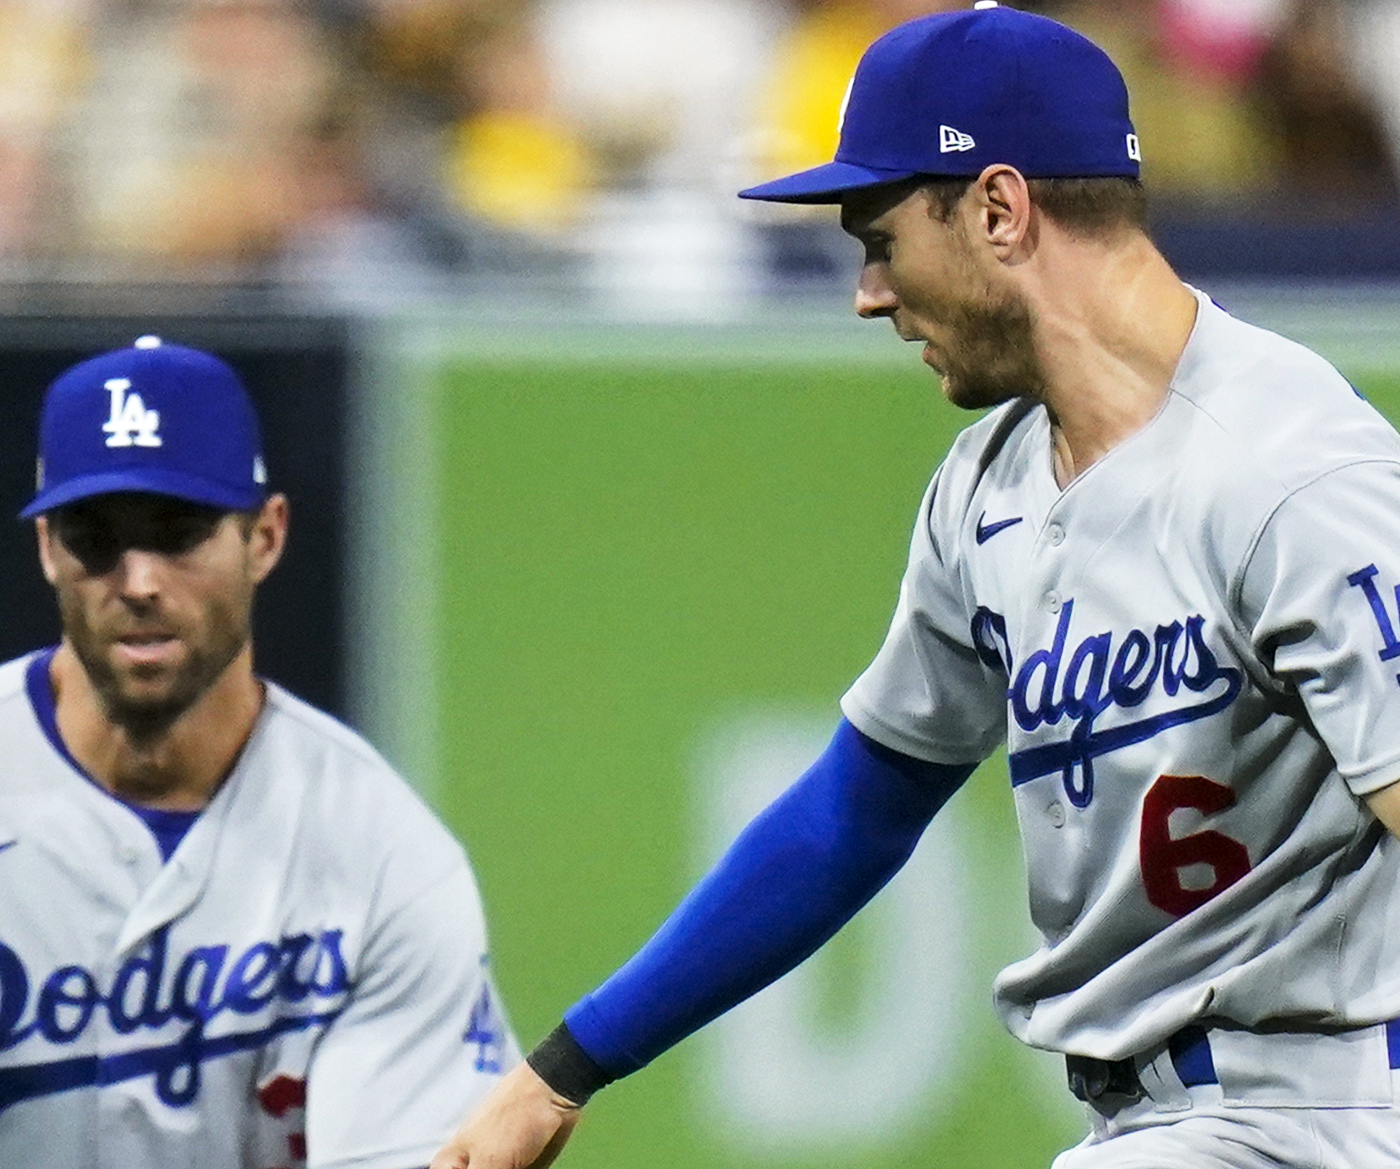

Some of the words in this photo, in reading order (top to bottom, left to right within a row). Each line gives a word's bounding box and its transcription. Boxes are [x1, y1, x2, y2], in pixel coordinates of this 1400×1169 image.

[102, 378, 162, 447] LA
[970, 597, 1242, 808] dgers
[1139, 774, 1252, 919] 6
